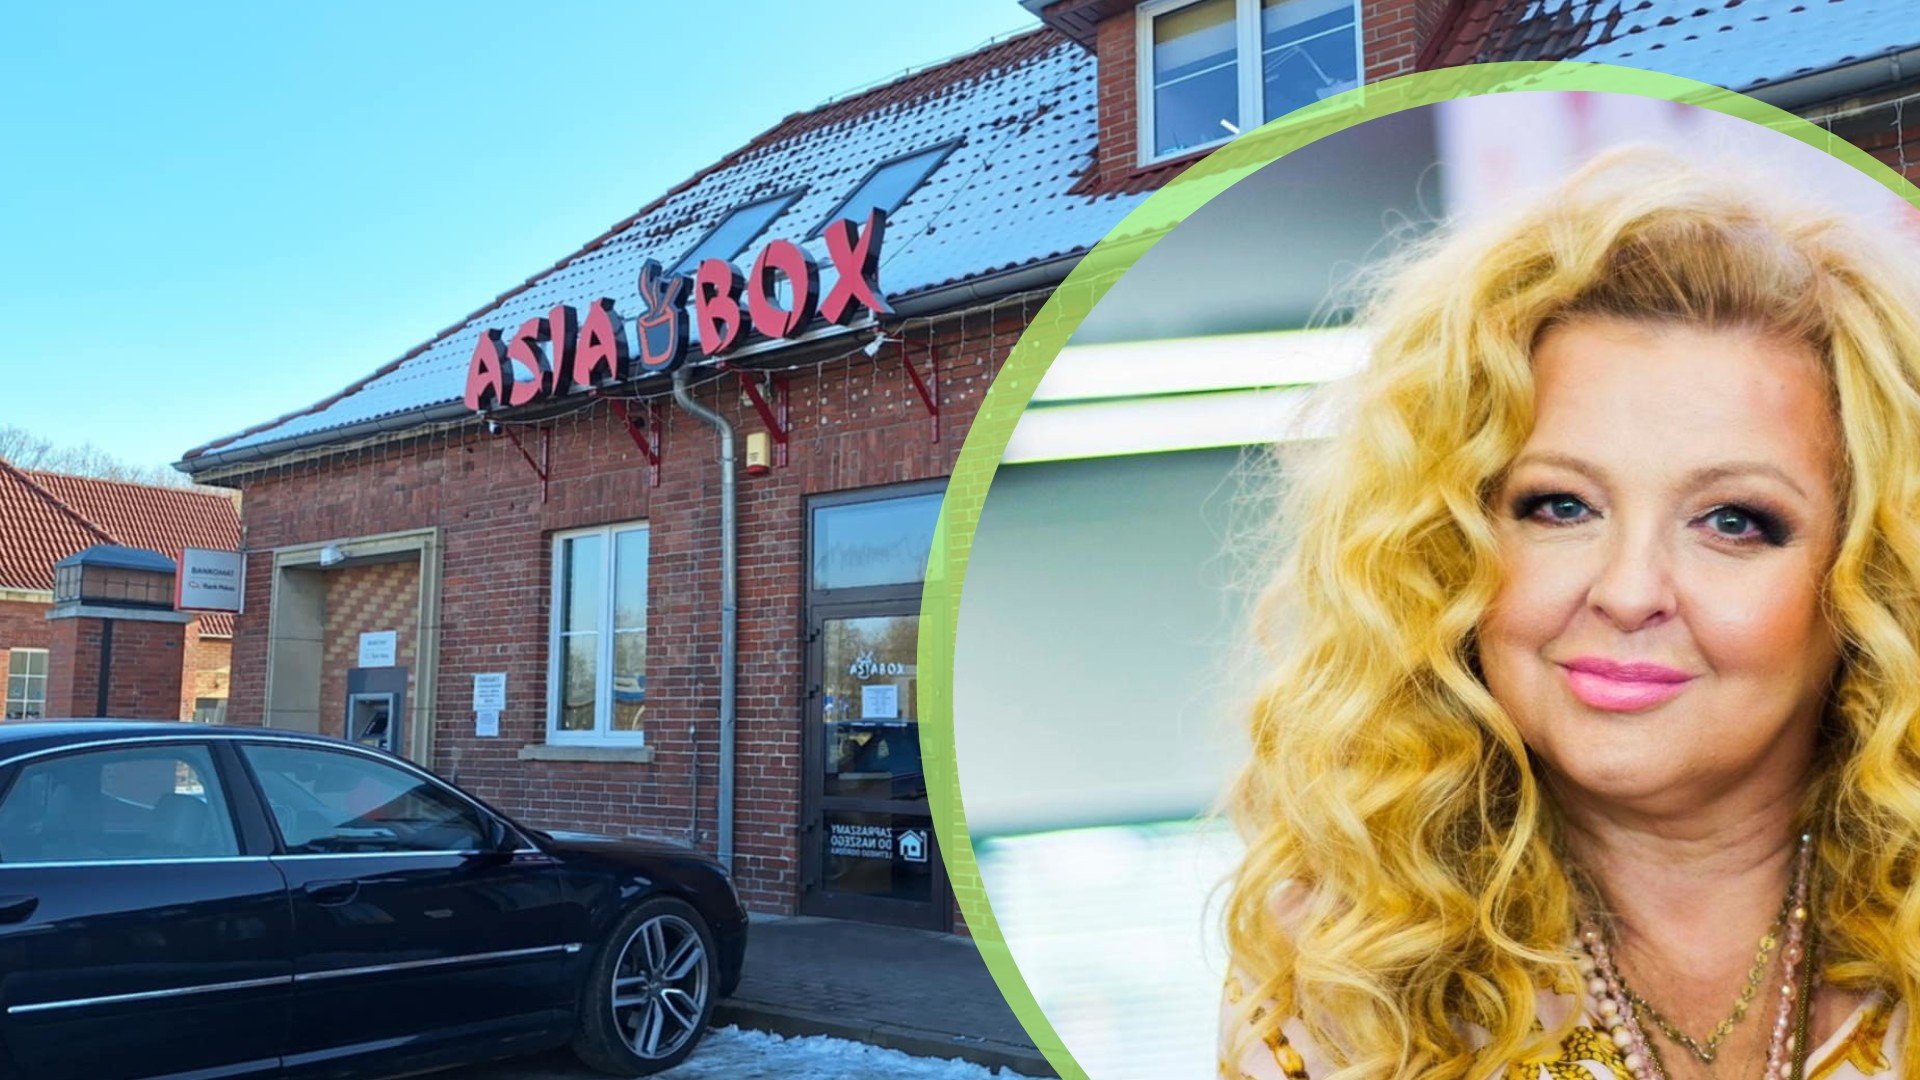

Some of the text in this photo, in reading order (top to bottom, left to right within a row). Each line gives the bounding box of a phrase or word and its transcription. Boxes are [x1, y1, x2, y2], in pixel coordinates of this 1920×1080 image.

[464, 207, 893, 411] ASIA BOX
[191, 566, 234, 576] BANKOMAT
